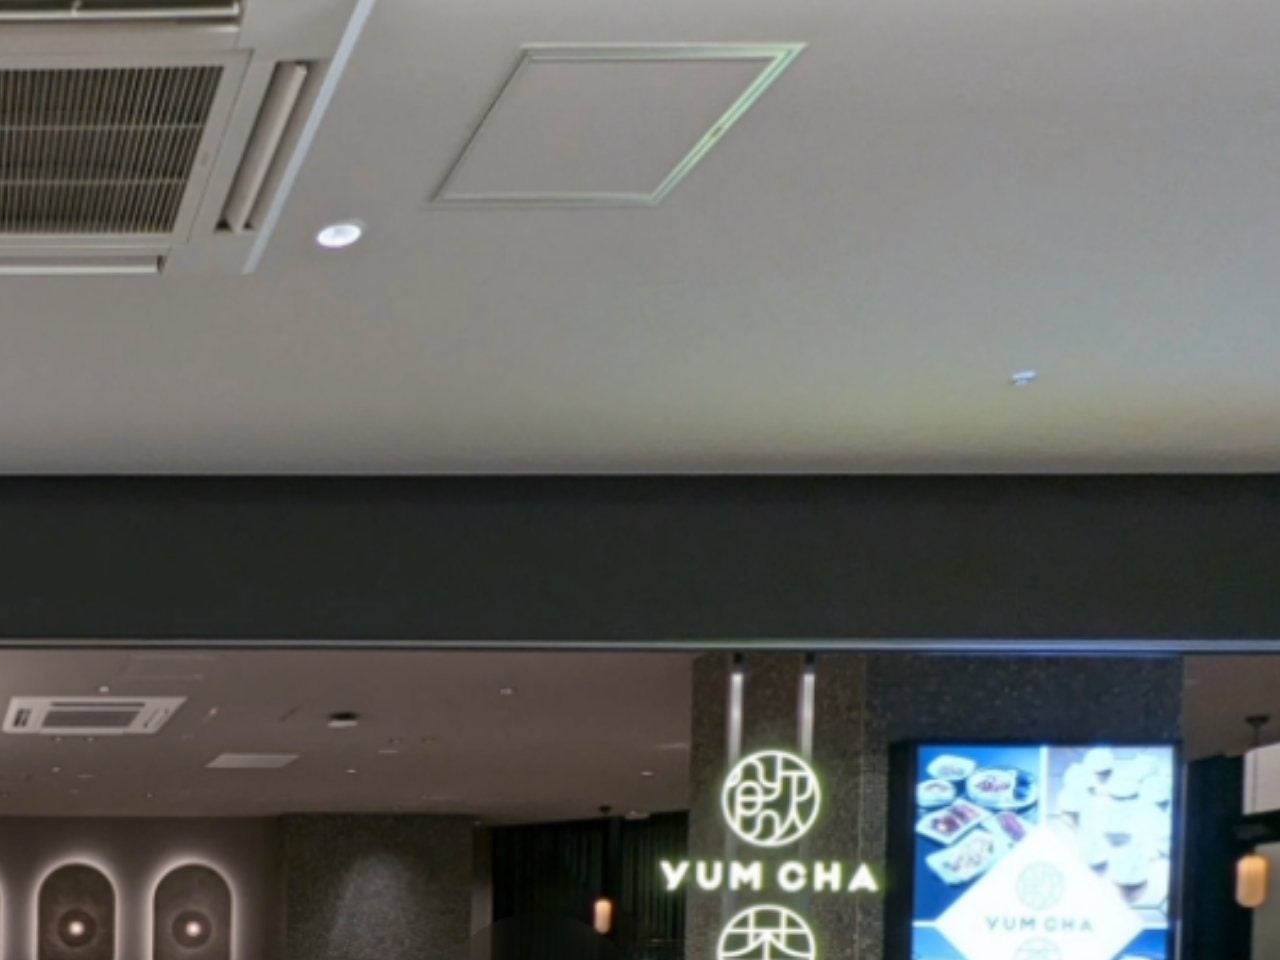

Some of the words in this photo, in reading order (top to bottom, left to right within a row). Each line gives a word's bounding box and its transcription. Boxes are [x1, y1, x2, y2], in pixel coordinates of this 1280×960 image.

[660, 860, 763, 892] YUM
[777, 860, 879, 893] CHA
[986, 917, 1036, 931] YUM
[1043, 917, 1093, 932] CHA
